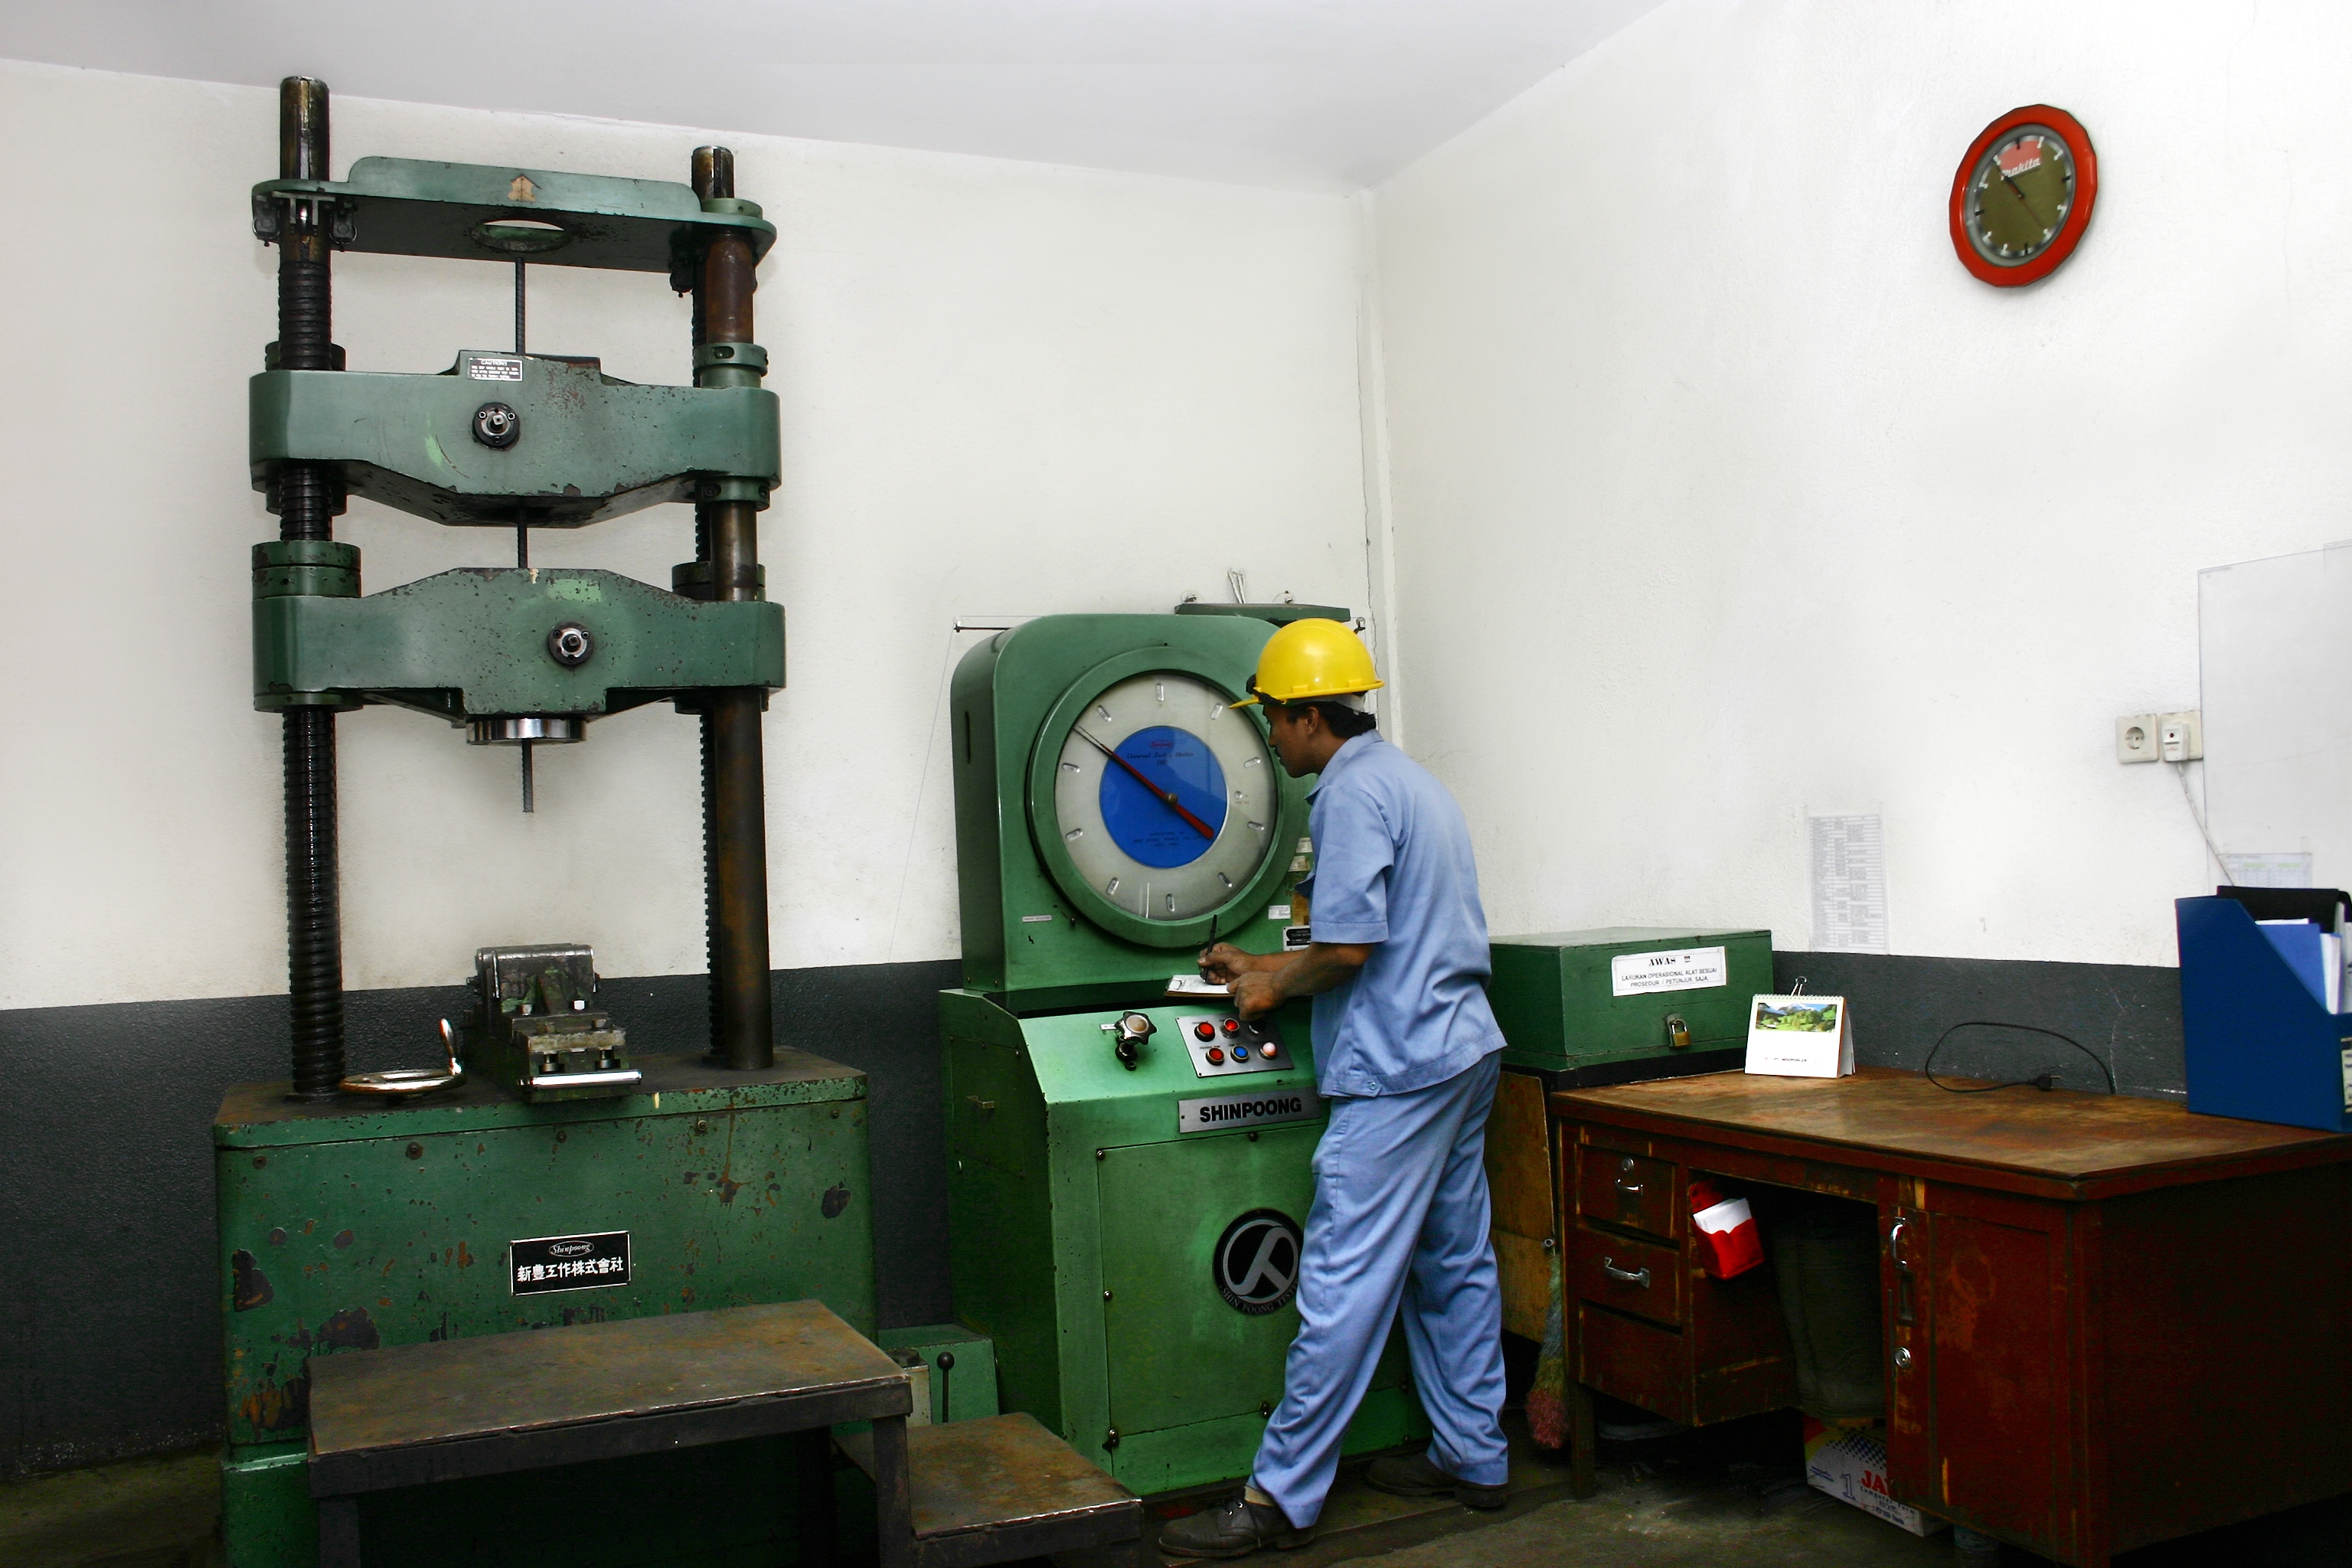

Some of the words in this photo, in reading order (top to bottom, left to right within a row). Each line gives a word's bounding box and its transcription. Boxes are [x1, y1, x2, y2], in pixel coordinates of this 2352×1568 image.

[1648, 957, 1676, 966] AWAS
[1200, 1097, 1302, 1122] SHINPOONG
[553, 1244, 590, 1254] Shinpoong
[1221, 1288, 1240, 1308] SHIN
[1242, 1304, 1274, 1314] POONG
[1861, 1470, 1887, 1495] JA
